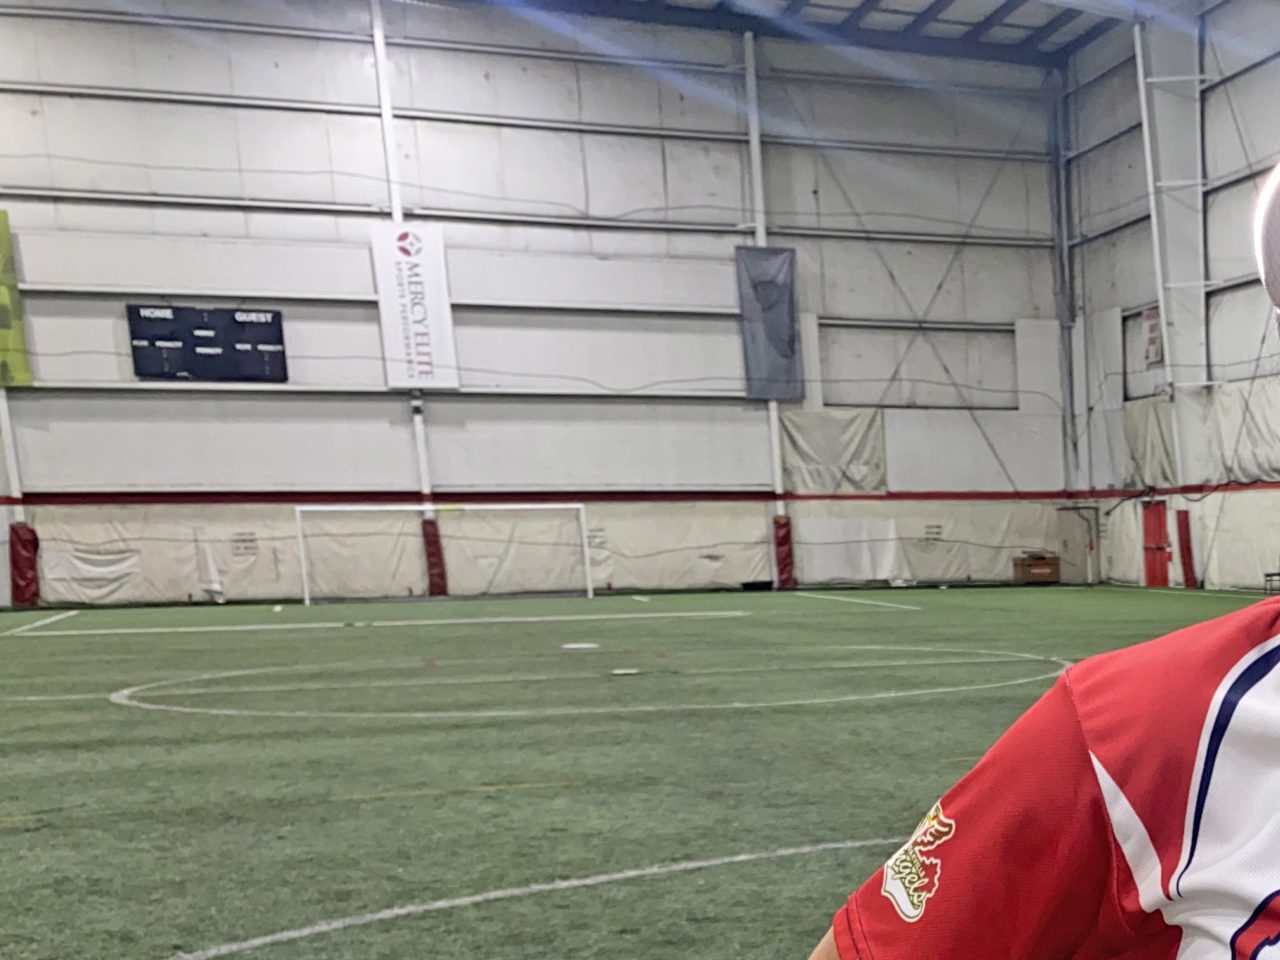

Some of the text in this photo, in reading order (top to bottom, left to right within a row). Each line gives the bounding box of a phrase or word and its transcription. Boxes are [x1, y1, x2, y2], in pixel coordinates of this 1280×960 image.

[395, 260, 406, 299] SPORTS
[139, 307, 174, 319] HOME
[234, 310, 274, 323] GUEST
[405, 261, 434, 379] MERCY ELITE
